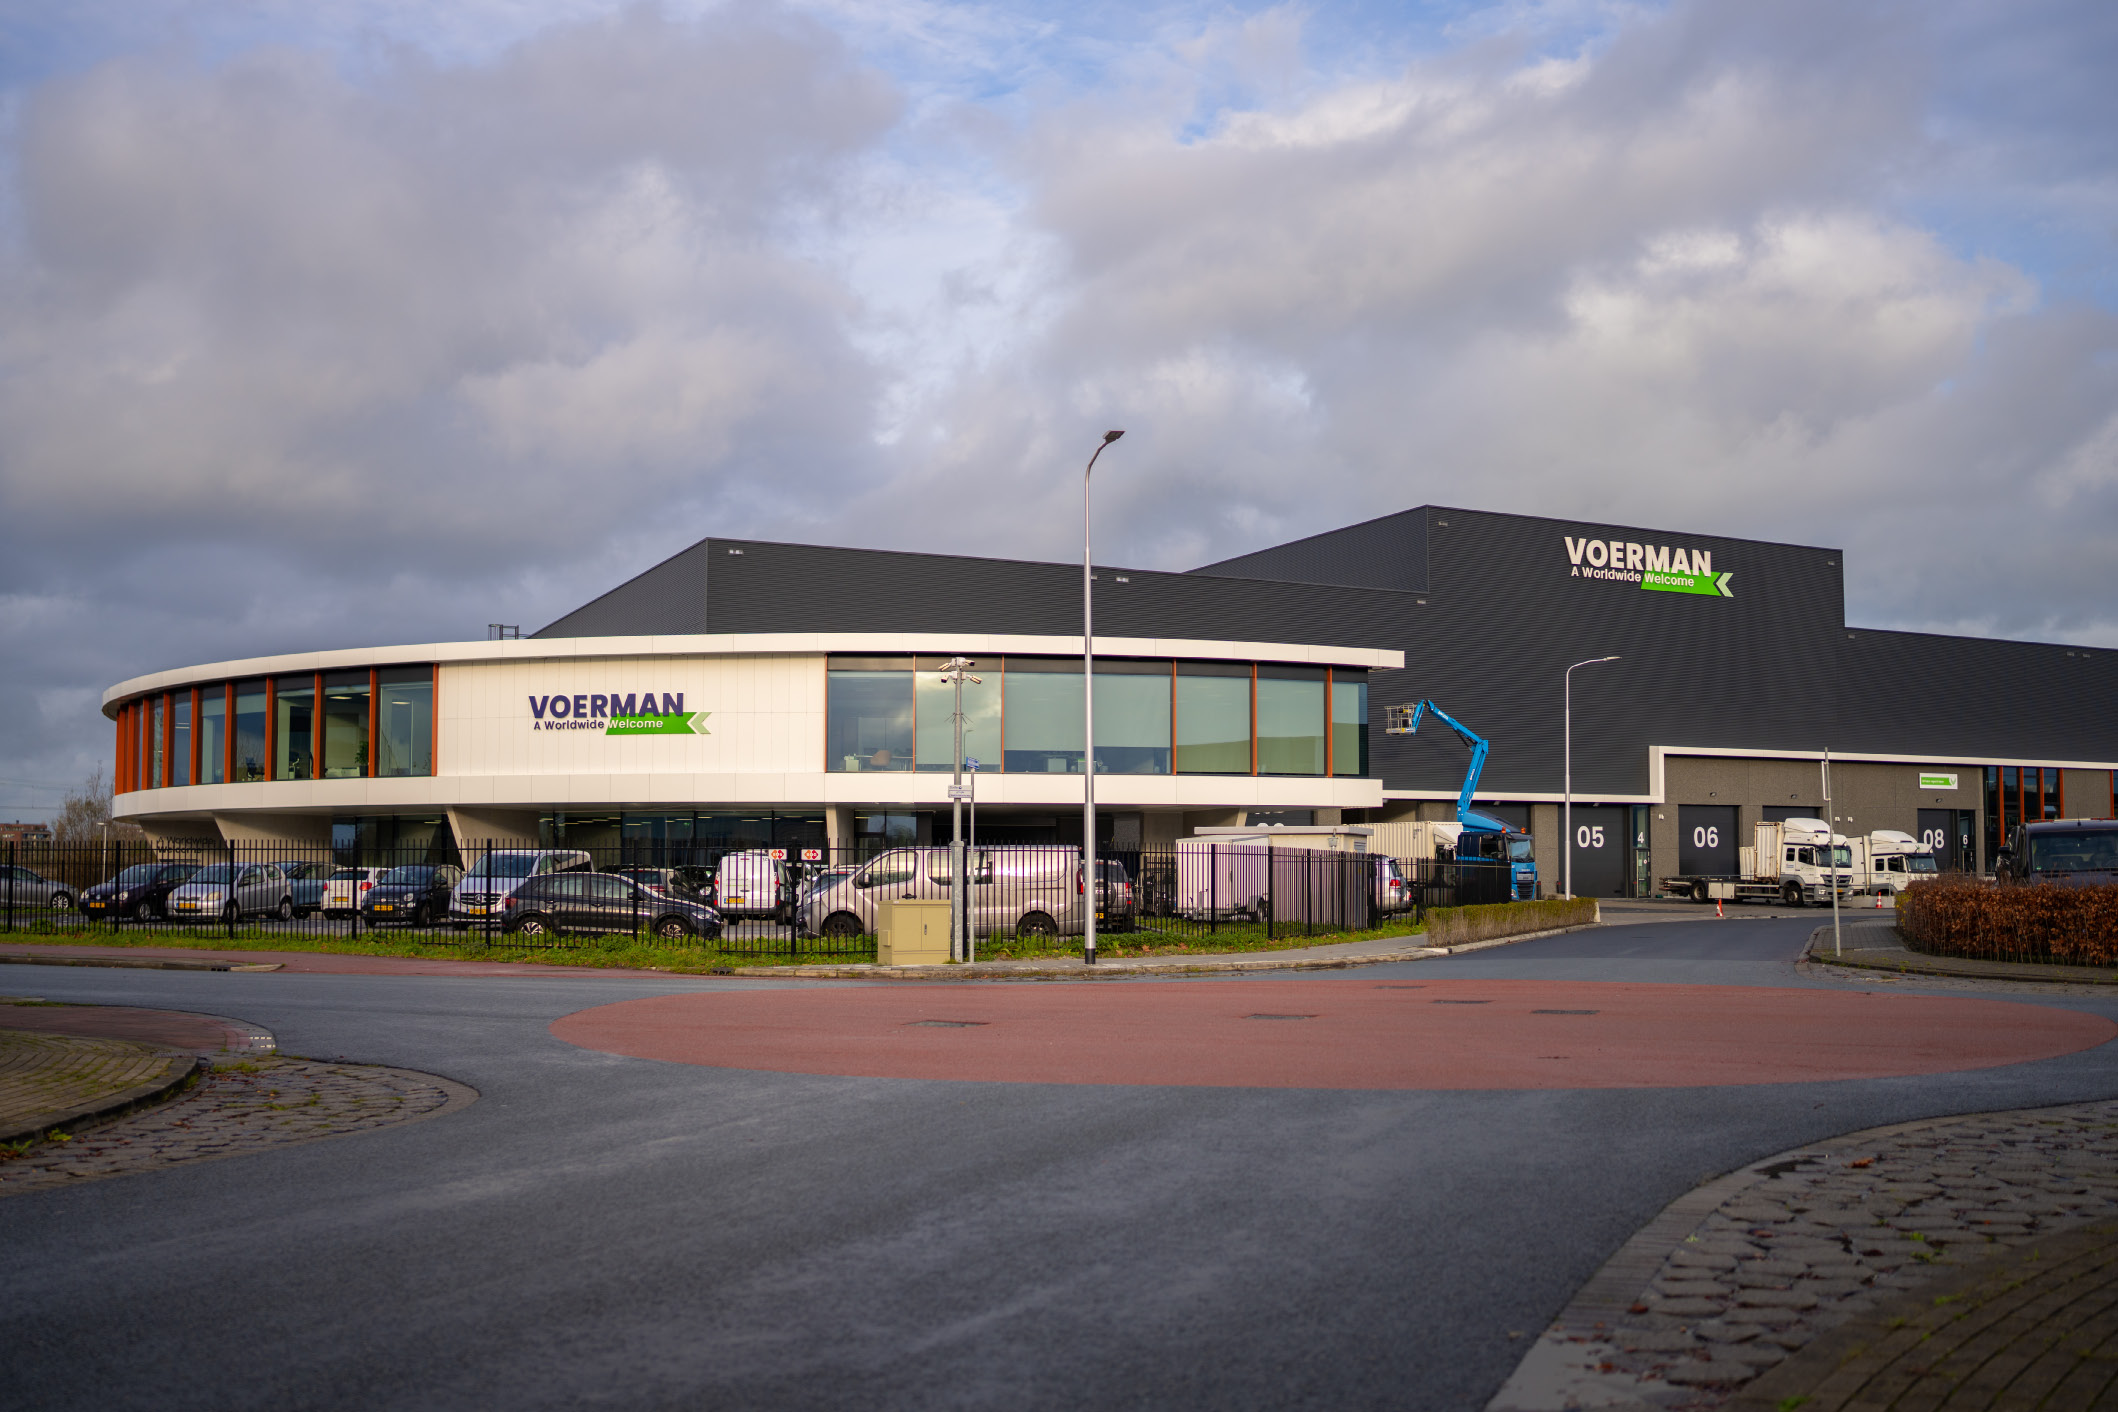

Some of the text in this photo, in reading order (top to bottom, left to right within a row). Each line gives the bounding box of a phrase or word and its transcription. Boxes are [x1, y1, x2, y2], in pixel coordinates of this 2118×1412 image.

[1564, 536, 1712, 577] VOERMAN
[1571, 566, 1695, 587] A Worldwide Welcome
[529, 693, 684, 719] VOERMAN
[533, 718, 663, 730] A Worldwide Welcome
[1577, 825, 1604, 848] 05
[1637, 831, 1644, 844] 4
[1693, 826, 1719, 848] 06
[1923, 829, 1945, 849] 08
[1962, 834, 1968, 845] 6
[157, 846, 202, 854] Wecome
